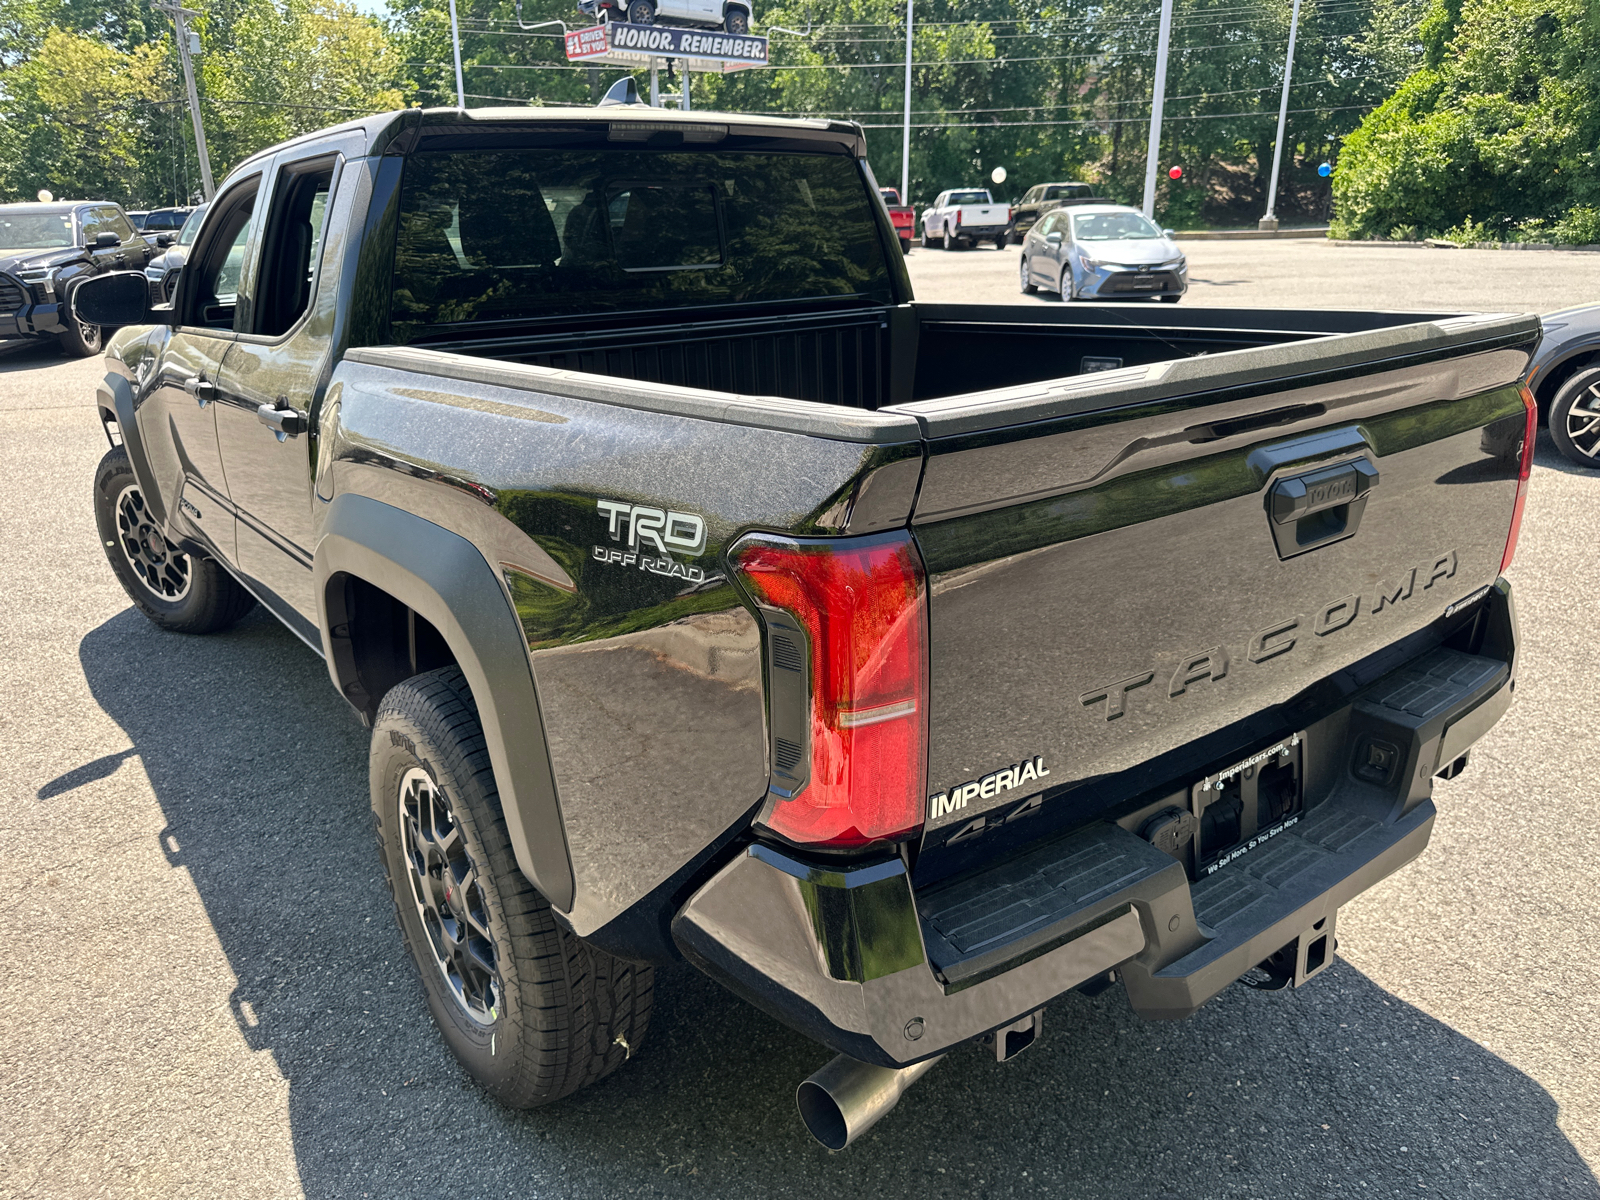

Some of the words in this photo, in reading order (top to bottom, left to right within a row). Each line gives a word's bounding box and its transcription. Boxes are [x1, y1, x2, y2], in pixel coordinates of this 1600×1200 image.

[567, 35, 582, 55] #1
[580, 29, 604, 43] DRIVEN
[582, 42, 591, 54] BY
[590, 40, 606, 52] YOU
[614, 27, 675, 50] HONOR.
[680, 34, 765, 58] REMEMBER.
[1309, 481, 1354, 504] TOYOTA
[597, 499, 708, 559] TRD
[592, 545, 636, 567] OFF
[639, 554, 705, 583] ROAD
[1079, 549, 1458, 722] TACOMA
[1219, 743, 1284, 781] Imperialcars.com
[930, 755, 1050, 820] IMPERIAL
[1207, 864, 1219, 875] We
[1219, 855, 1231, 868] Sell
[1248, 840, 1257, 850] So
[1257, 833, 1270, 844] You
[1269, 825, 1284, 838] Save
[1283, 817, 1298, 829] More
